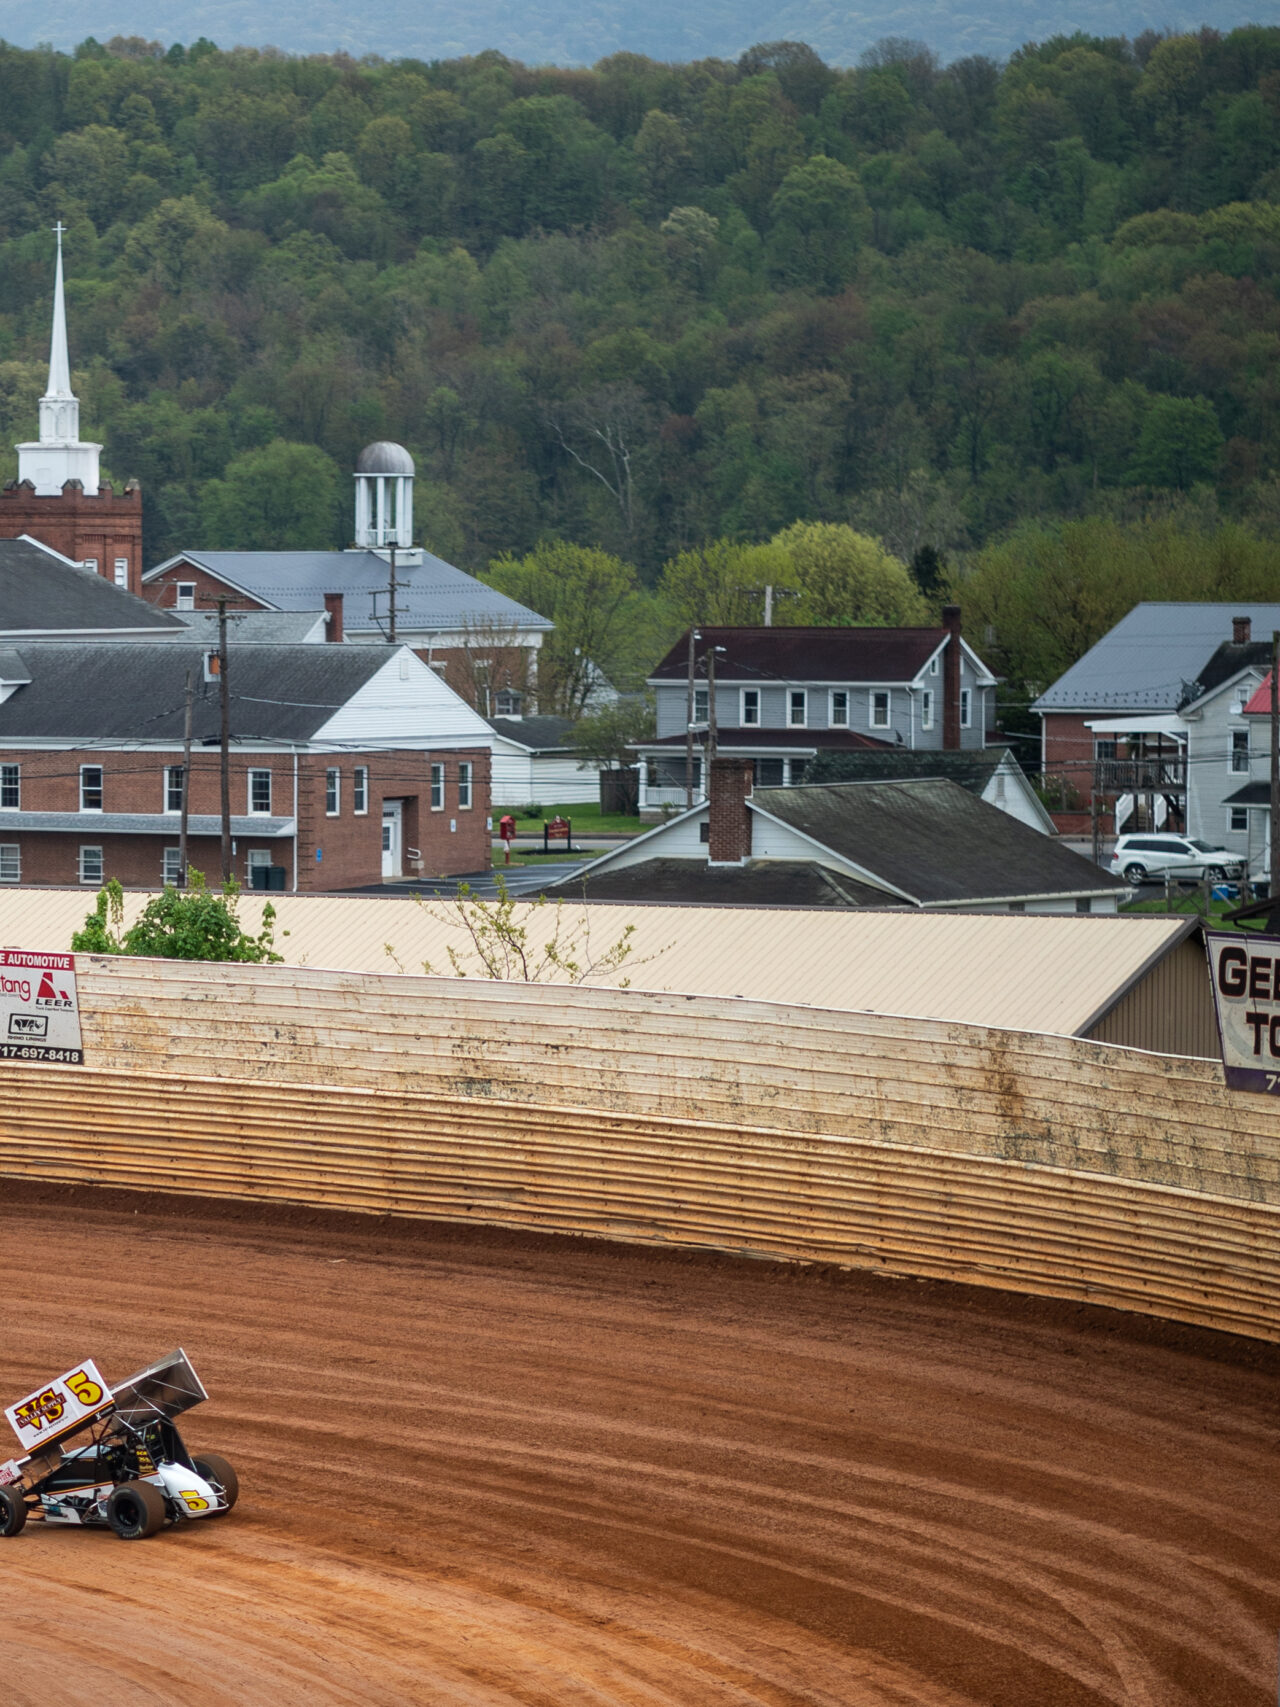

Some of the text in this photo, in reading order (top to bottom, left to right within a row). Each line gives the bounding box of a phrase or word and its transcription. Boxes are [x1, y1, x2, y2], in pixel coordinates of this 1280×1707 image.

[8, 953, 70, 968] AUTOMOTIVE
[1218, 946, 1280, 1000] GE
[35, 998, 73, 1008] LEER
[64, 1369, 103, 1407] 5
[14, 1387, 64, 1430] VS
[20, 1397, 62, 1424] VALLEY SUPPLY
[179, 1490, 209, 1511] 5
